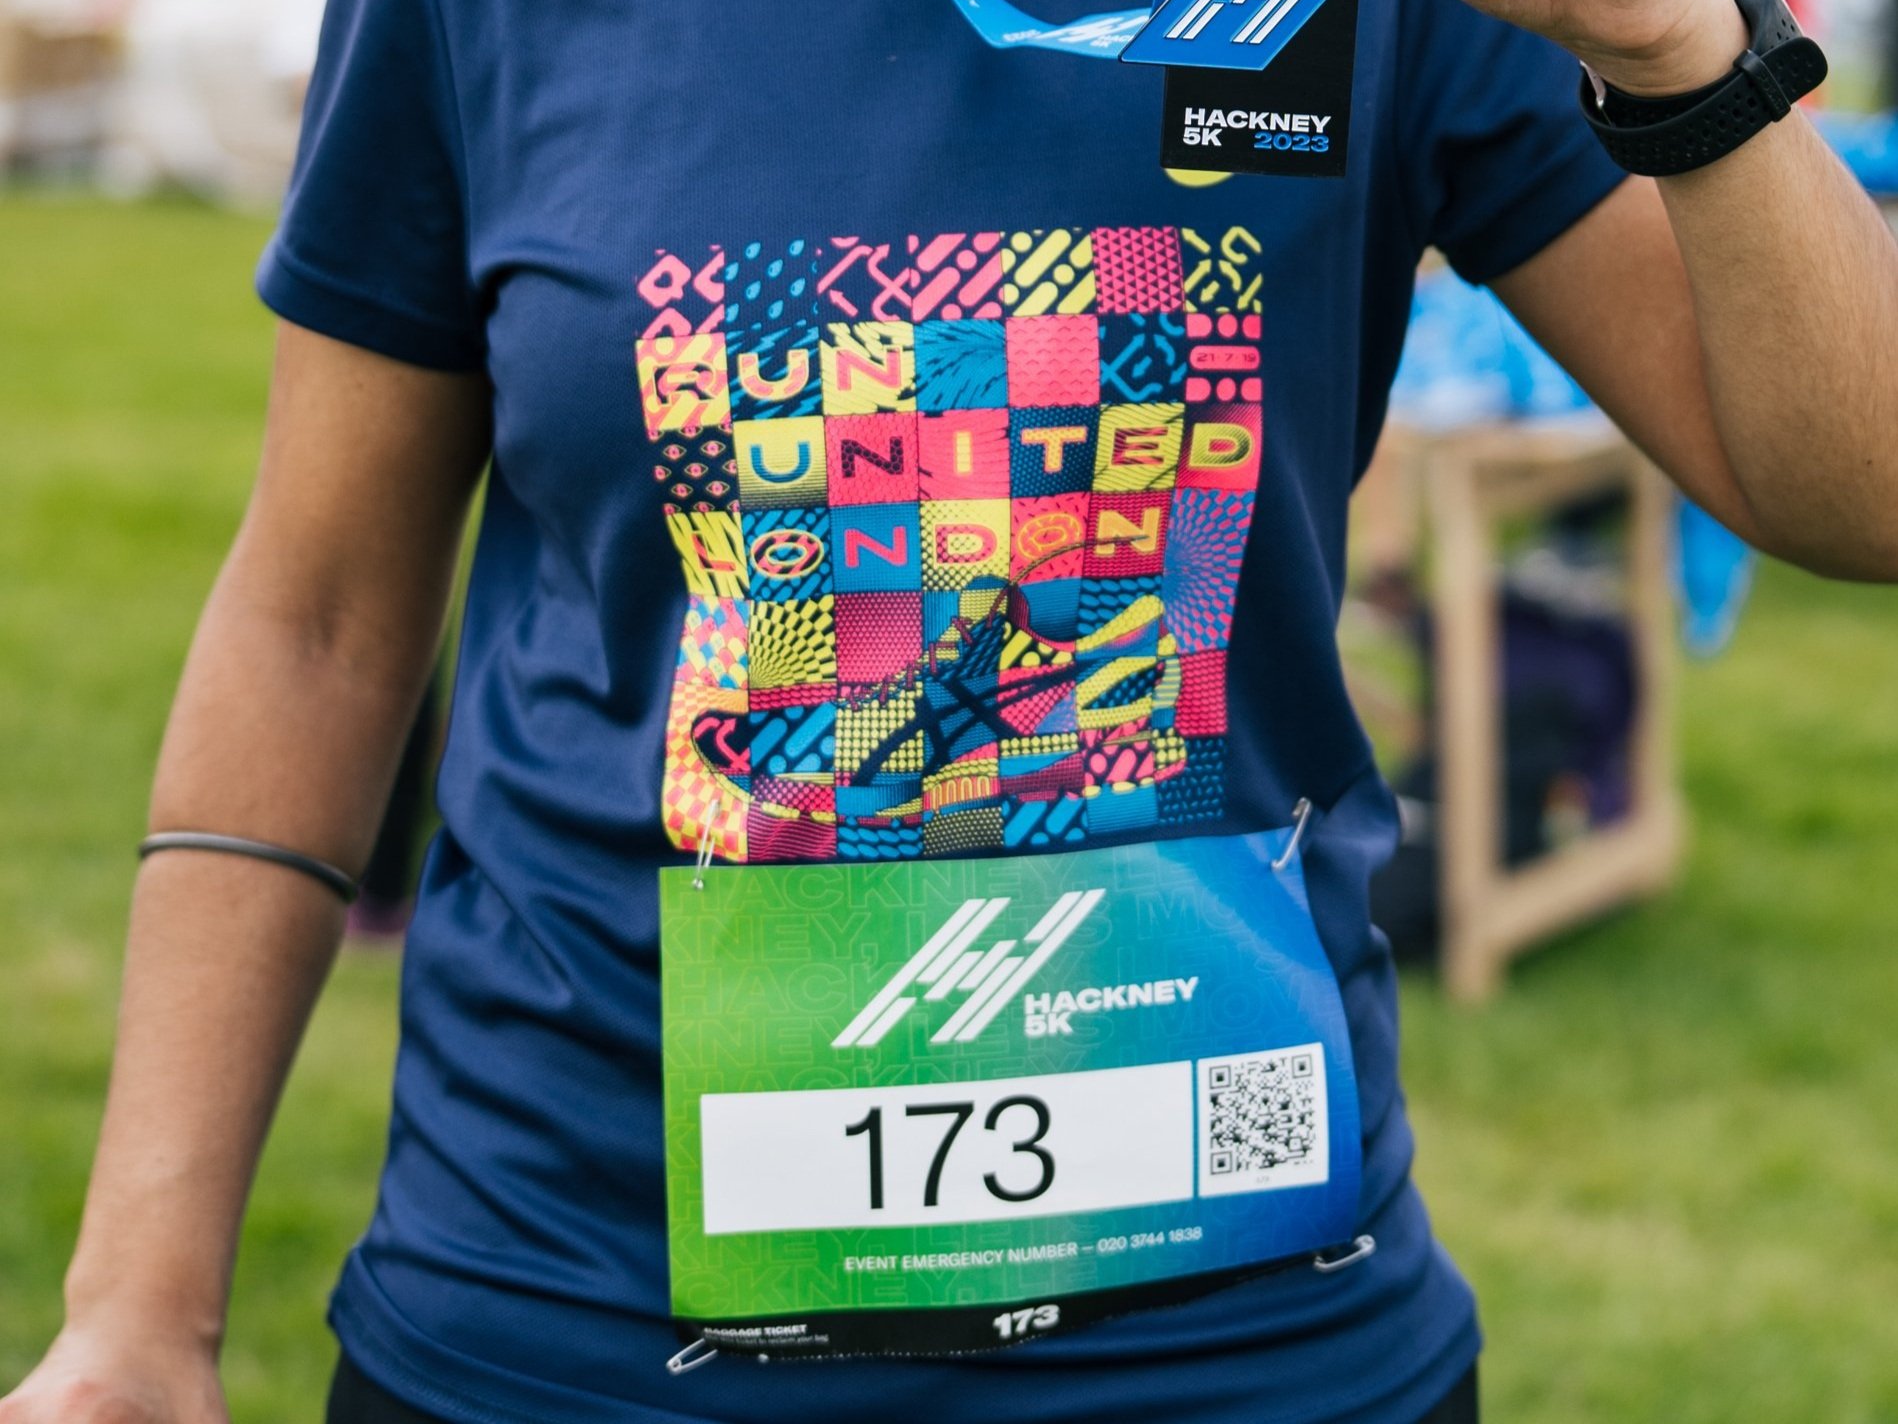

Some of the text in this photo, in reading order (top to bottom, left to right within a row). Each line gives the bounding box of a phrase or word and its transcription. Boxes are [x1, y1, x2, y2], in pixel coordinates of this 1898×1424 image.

[1182, 127, 1330, 152] 5K 2023
[1184, 107, 1331, 134] HACKNEY
[653, 347, 904, 405] RUN
[749, 423, 1255, 485] UNITED
[691, 506, 1163, 579] LONDON
[1024, 976, 1199, 1015] HACKNEY
[1024, 1012, 1073, 1037] 5K
[845, 1095, 1056, 1211] 173
[845, 1256, 897, 1272] EVENT
[902, 1250, 1003, 1269] EMERGENCY
[1008, 1242, 1078, 1262] NUMBER
[1098, 1237, 1127, 1253] 020
[1130, 1231, 1165, 1248] 3744
[1168, 1226, 1203, 1243] 1838
[764, 1324, 807, 1336] TICKET
[993, 1304, 1060, 1340] 173
